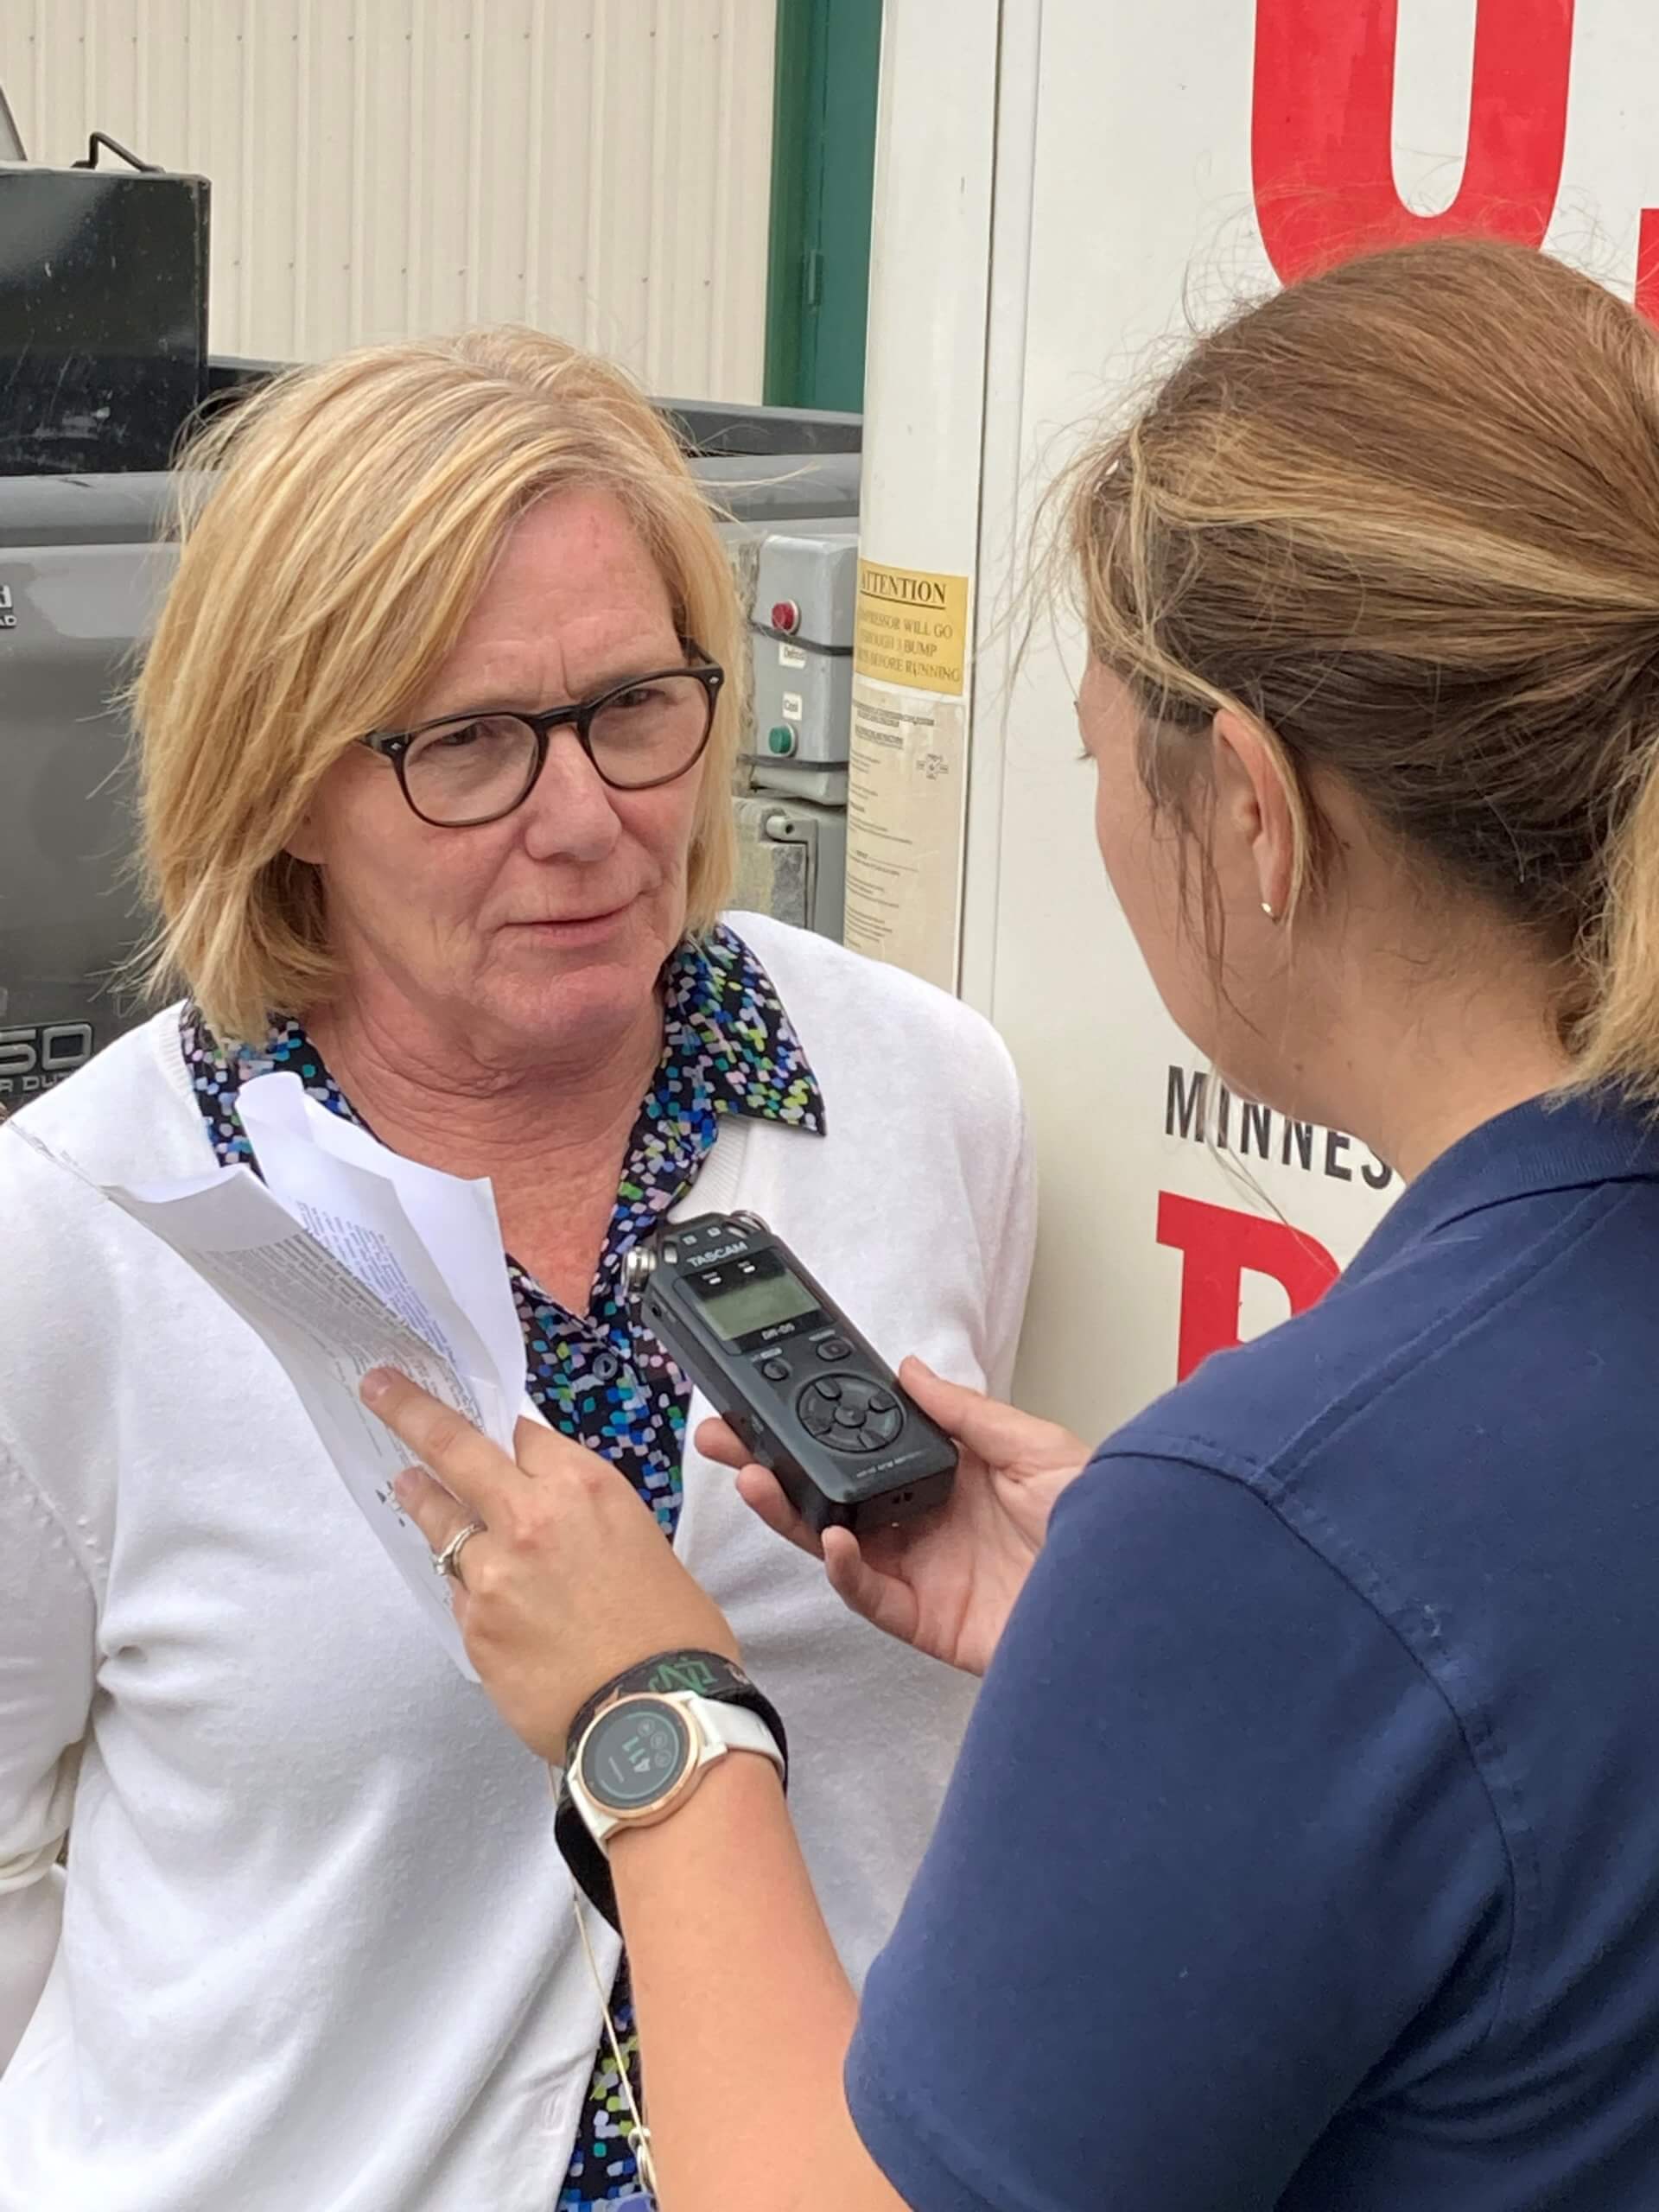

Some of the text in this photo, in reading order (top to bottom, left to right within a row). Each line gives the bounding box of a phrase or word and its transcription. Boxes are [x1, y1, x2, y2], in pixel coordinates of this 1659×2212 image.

[903, 617, 931, 636] WILL
[933, 623, 954, 639] GO
[904, 639, 938, 657] BUMP
[905, 659, 961, 683] RUNNING
[686, 1241, 748, 1268] TASCAM
